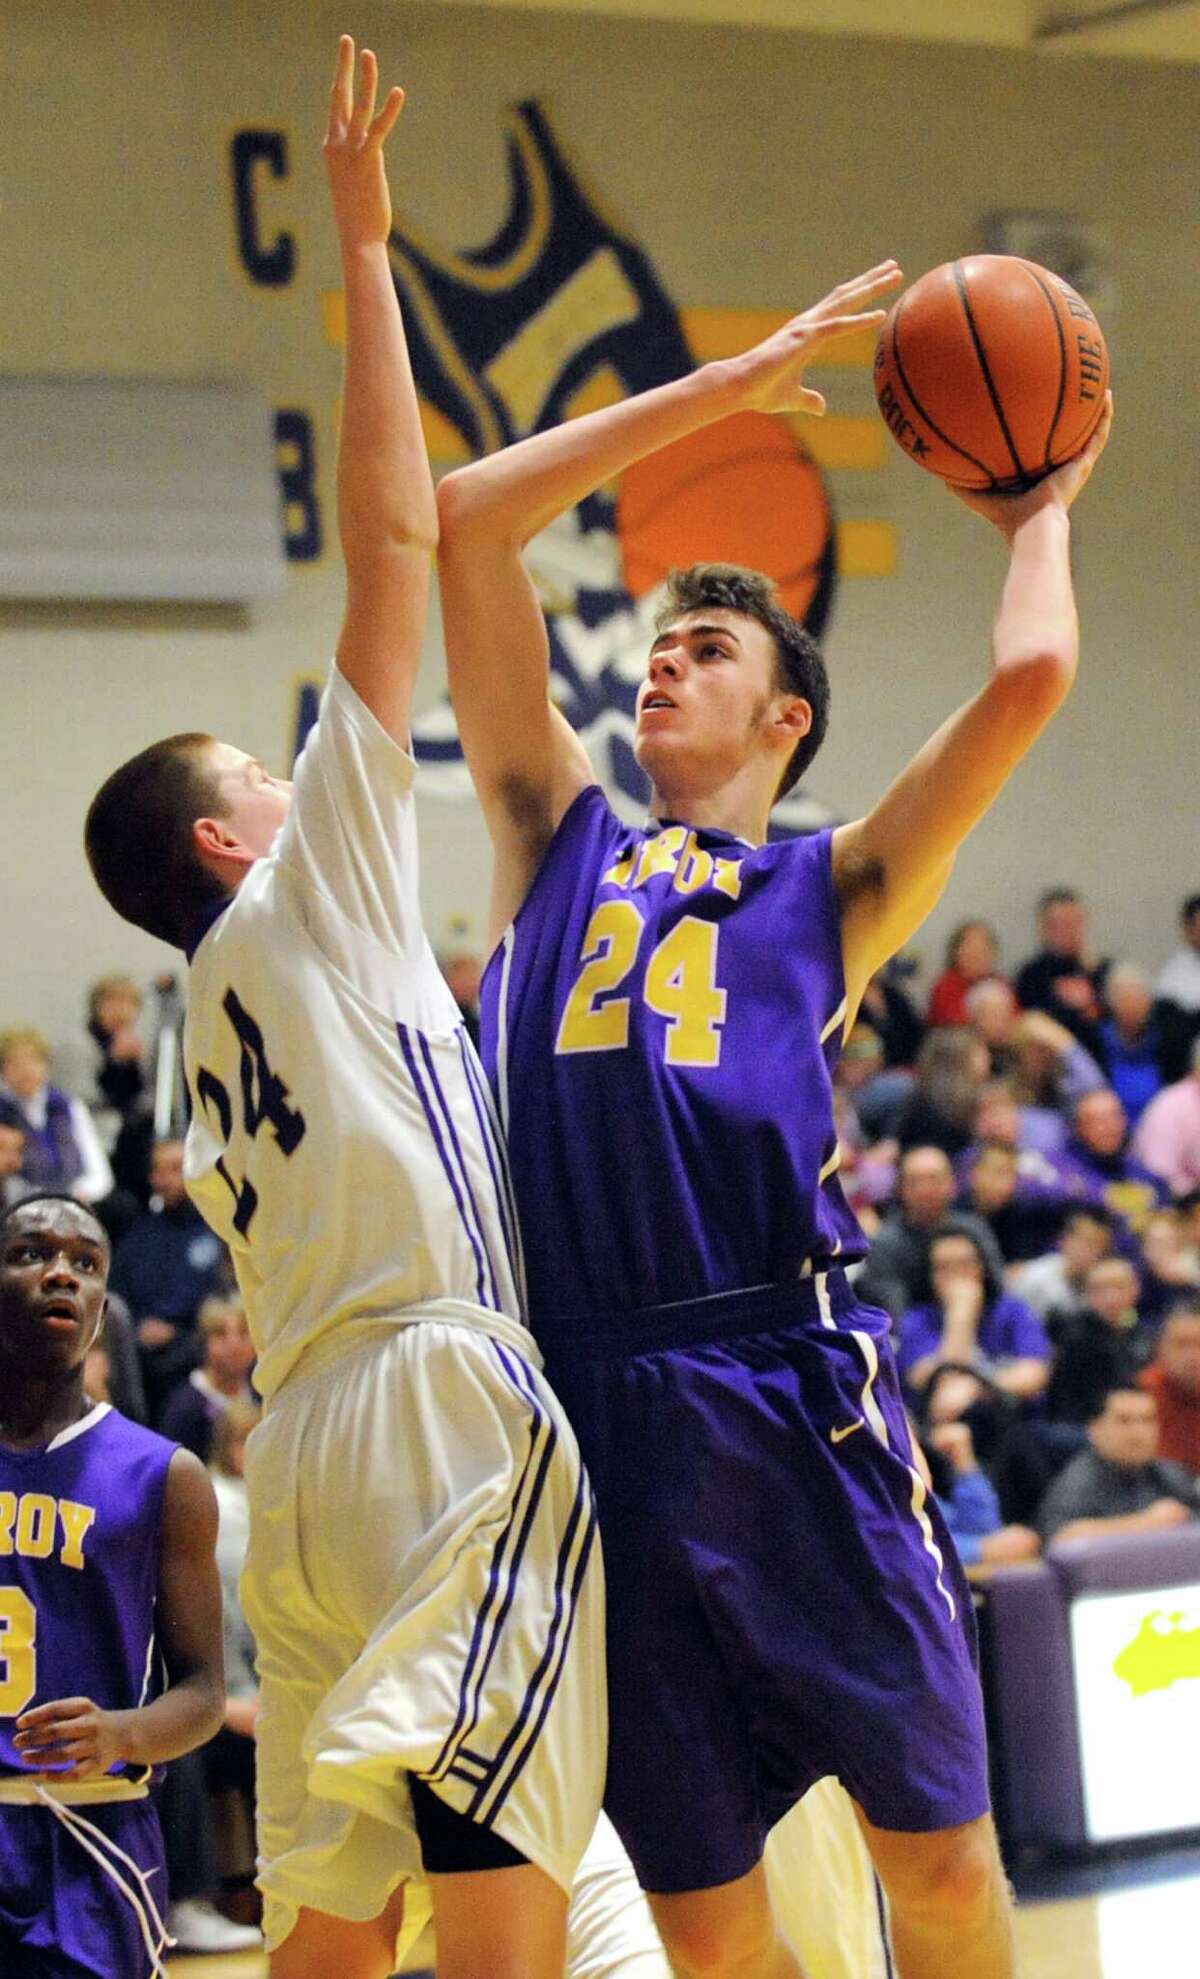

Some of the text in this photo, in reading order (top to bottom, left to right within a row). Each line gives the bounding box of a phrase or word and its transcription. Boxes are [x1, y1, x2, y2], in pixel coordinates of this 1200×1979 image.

[231, 128, 296, 286] C
[1078, 335, 1102, 403] THE
[554, 899, 727, 1067] 24
[196, 983, 306, 1241] 24
